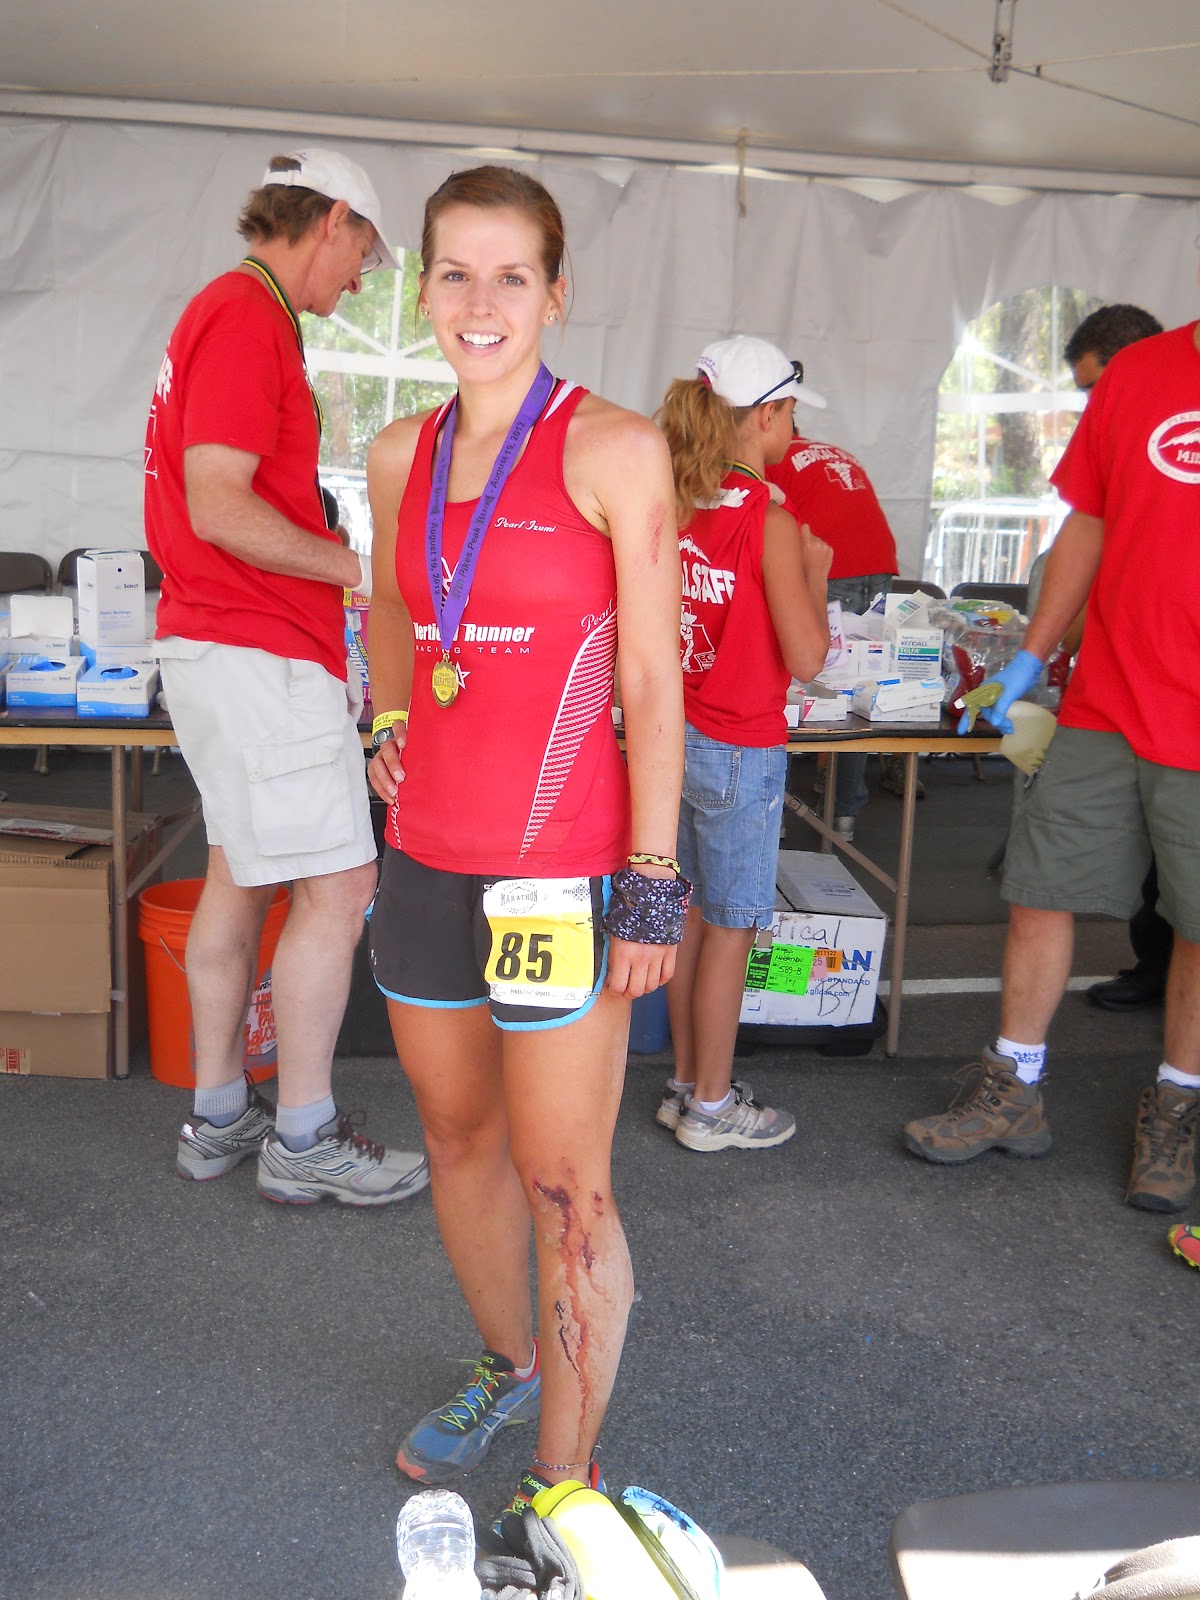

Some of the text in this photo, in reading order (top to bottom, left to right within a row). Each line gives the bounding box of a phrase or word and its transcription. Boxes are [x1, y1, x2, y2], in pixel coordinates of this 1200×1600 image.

[791, 447, 839, 473] MEDICAL
[458, 551, 474, 578] Pikes
[467, 525, 481, 553] Peak
[490, 455, 510, 489] August
[510, 420, 527, 443] 2012
[494, 517, 557, 534] Pearl Izumi
[429, 522, 439, 557] August
[580, 597, 614, 634] Pearl
[461, 623, 536, 642] Runner
[477, 646, 530, 654] TEAM
[500, 889, 538, 907] MARATHON
[495, 931, 554, 983] 85
[827, 976, 871, 986] STANDARD
